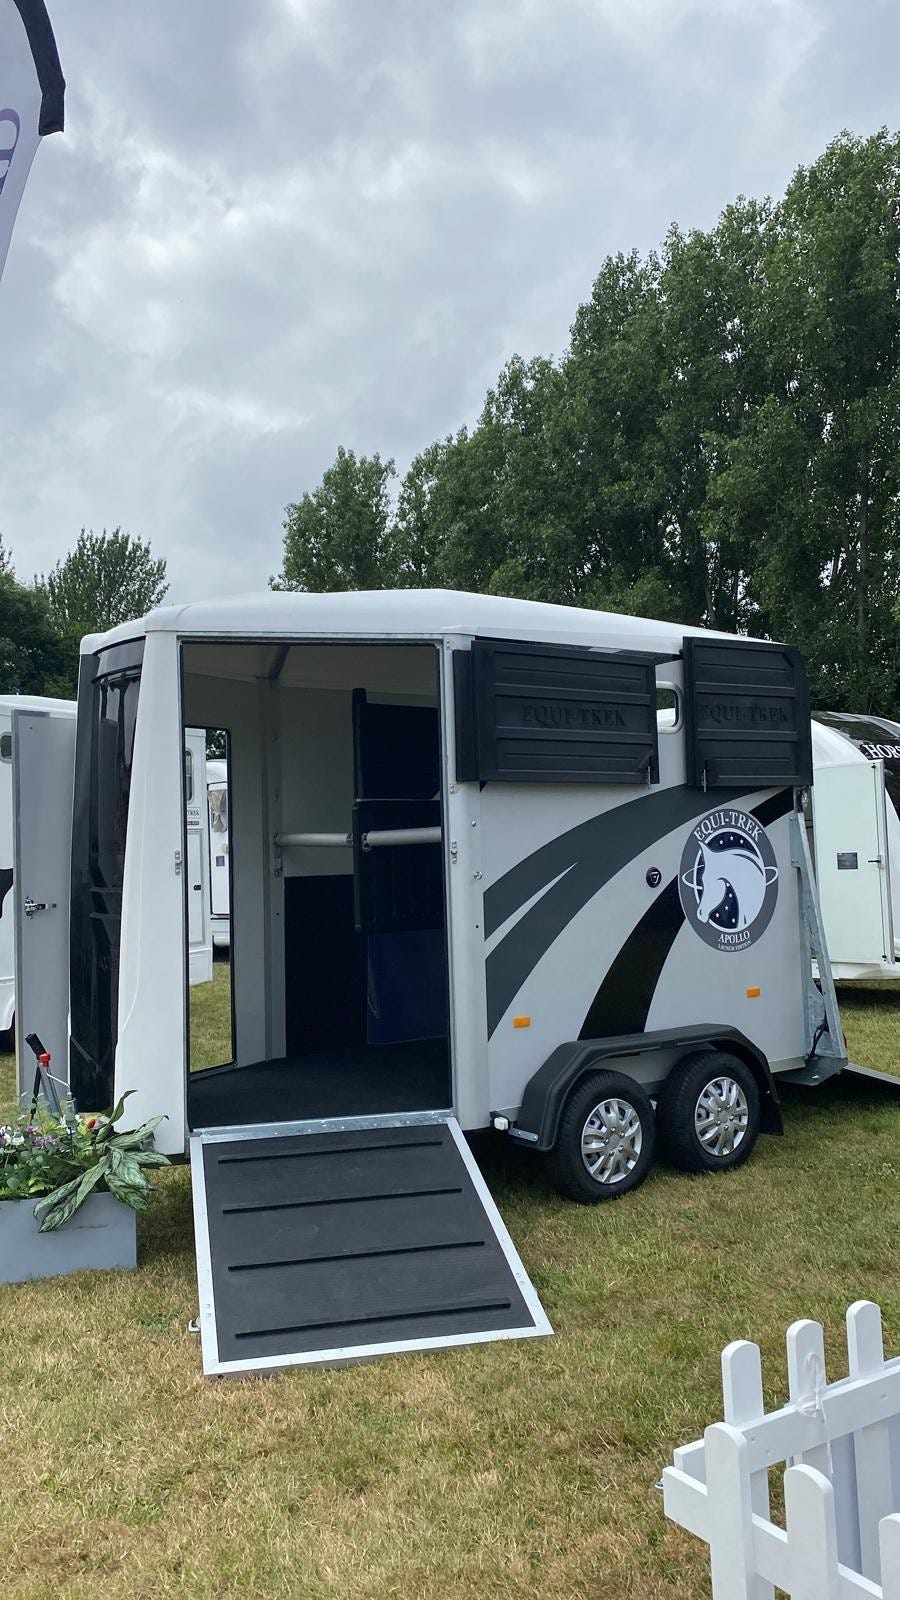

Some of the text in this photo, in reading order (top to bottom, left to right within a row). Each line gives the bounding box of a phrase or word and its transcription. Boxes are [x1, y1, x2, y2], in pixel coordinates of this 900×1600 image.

[521, 704, 626, 727] EQUI-TREK
[697, 703, 788, 724] EQUI-TREK
[693, 811, 763, 842] EQUI-TREK
[718, 930, 750, 943] APOLLO
